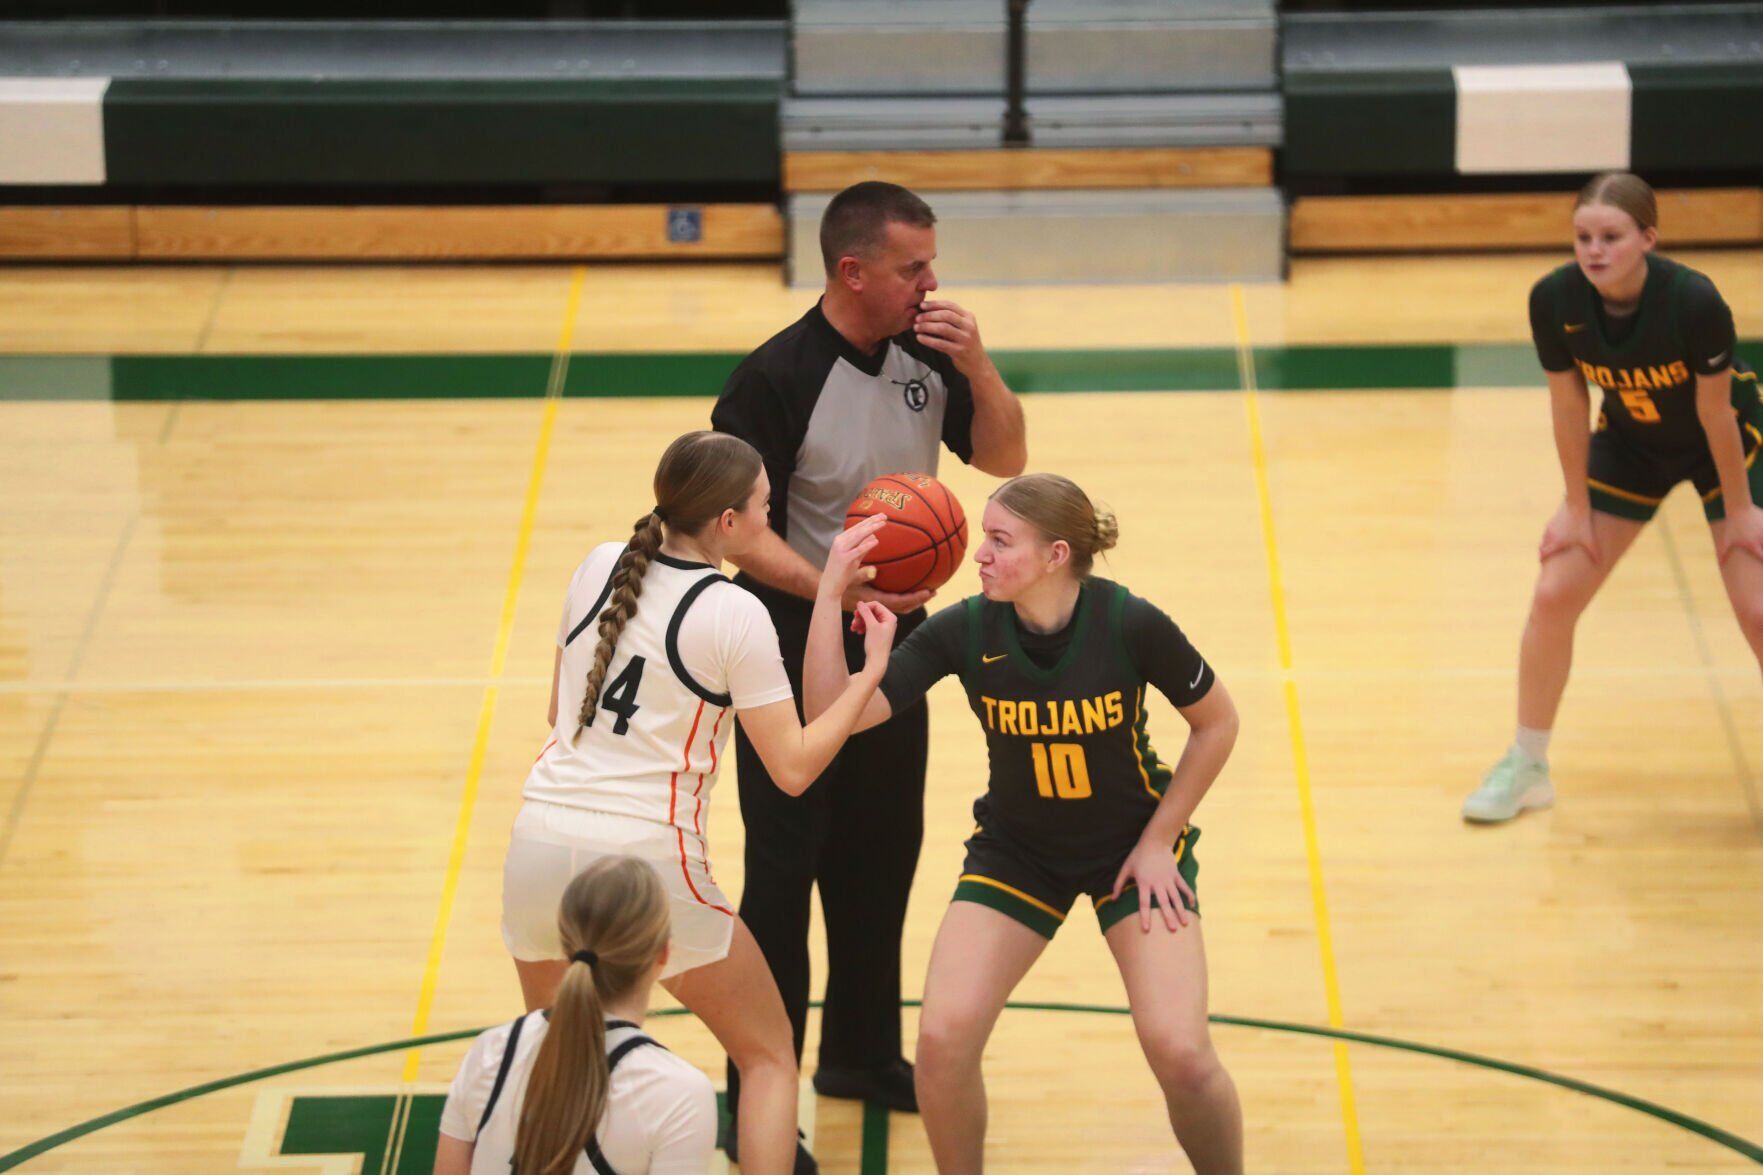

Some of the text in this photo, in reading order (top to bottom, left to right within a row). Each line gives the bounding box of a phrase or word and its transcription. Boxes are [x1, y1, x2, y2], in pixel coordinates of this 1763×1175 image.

[1619, 388, 1662, 423] 5
[584, 645, 647, 736] 4
[981, 690, 1124, 736] TROJANS
[1031, 742, 1093, 799] 10
